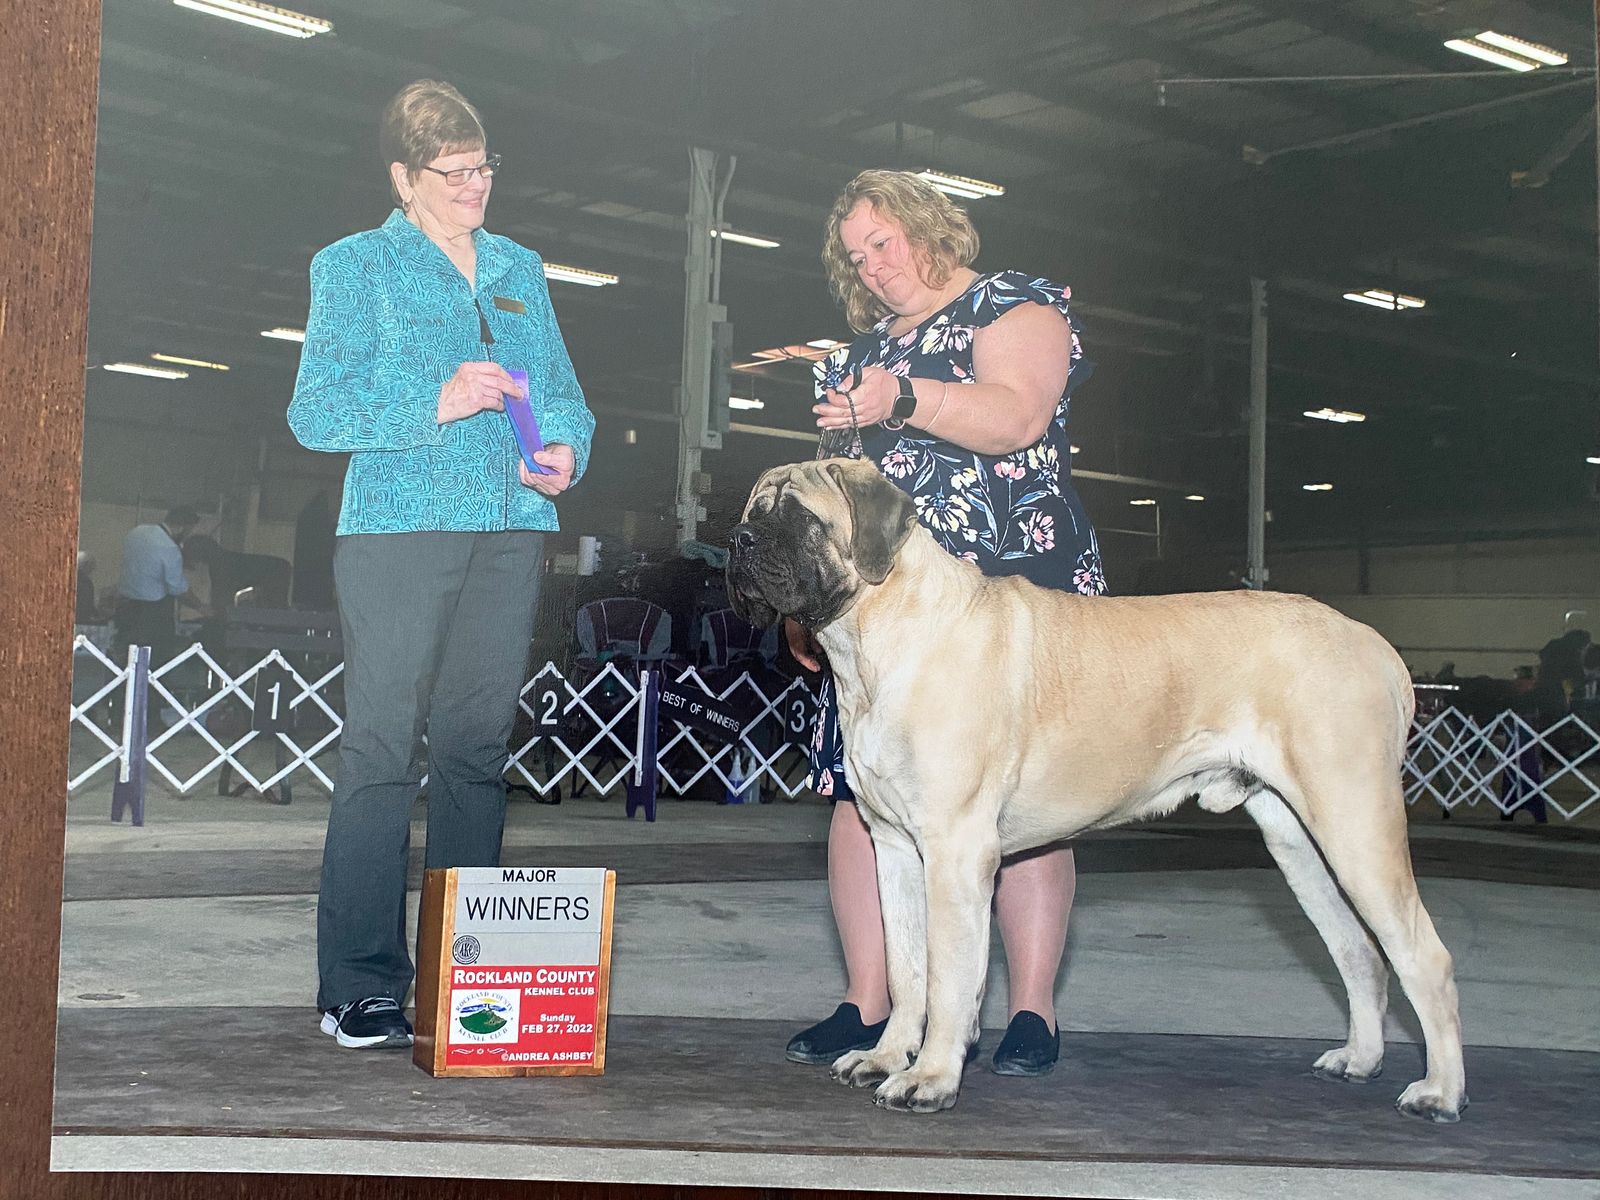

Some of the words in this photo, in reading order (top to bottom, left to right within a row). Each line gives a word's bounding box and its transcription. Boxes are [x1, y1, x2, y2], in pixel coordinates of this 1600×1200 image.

[267, 682, 280, 720] 1
[541, 690, 558, 725] 2
[662, 691, 685, 710] BEST
[689, 702, 702, 715] OF
[706, 709, 740, 733] WINNERS
[790, 699, 806, 733] 3
[502, 869, 557, 882] MAJOR
[465, 896, 589, 921] WINNERS
[454, 969, 532, 984] ROCKLAND
[536, 969, 596, 984] COUNTY
[524, 988, 566, 996] KENNEL
[568, 987, 595, 996] CLUB
[540, 1013, 576, 1023] Sunday
[522, 1024, 543, 1034] FEB
[547, 1024, 564, 1034] 27,
[566, 1024, 593, 1033] 2022
[552, 1051, 593, 1061] ASHBEY
